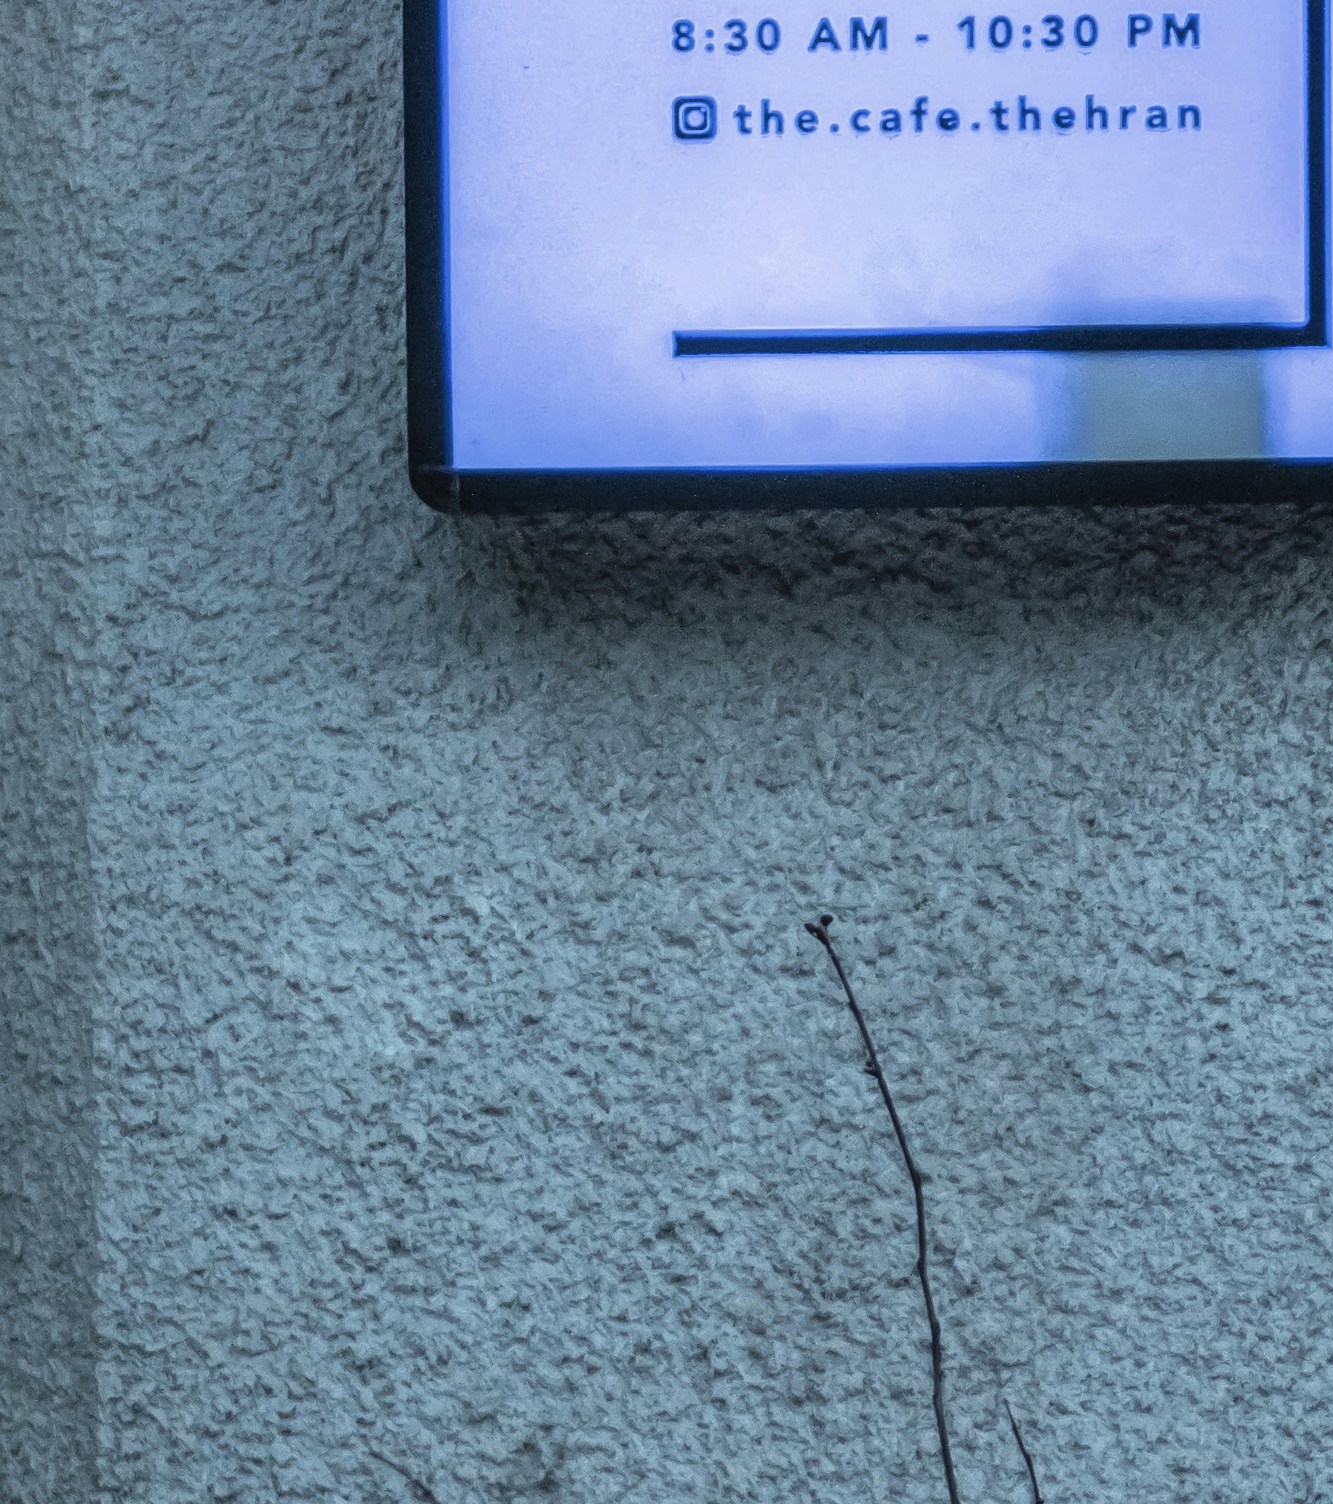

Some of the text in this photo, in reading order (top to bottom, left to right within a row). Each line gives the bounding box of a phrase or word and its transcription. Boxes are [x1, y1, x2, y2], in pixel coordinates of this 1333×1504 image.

[671, 17, 782, 56] 8:30
[807, 15, 890, 53] AM
[956, 14, 1099, 52] 10:30
[1127, 12, 1201, 49] PM
[732, 93, 1203, 137] the.cafe.thehran
